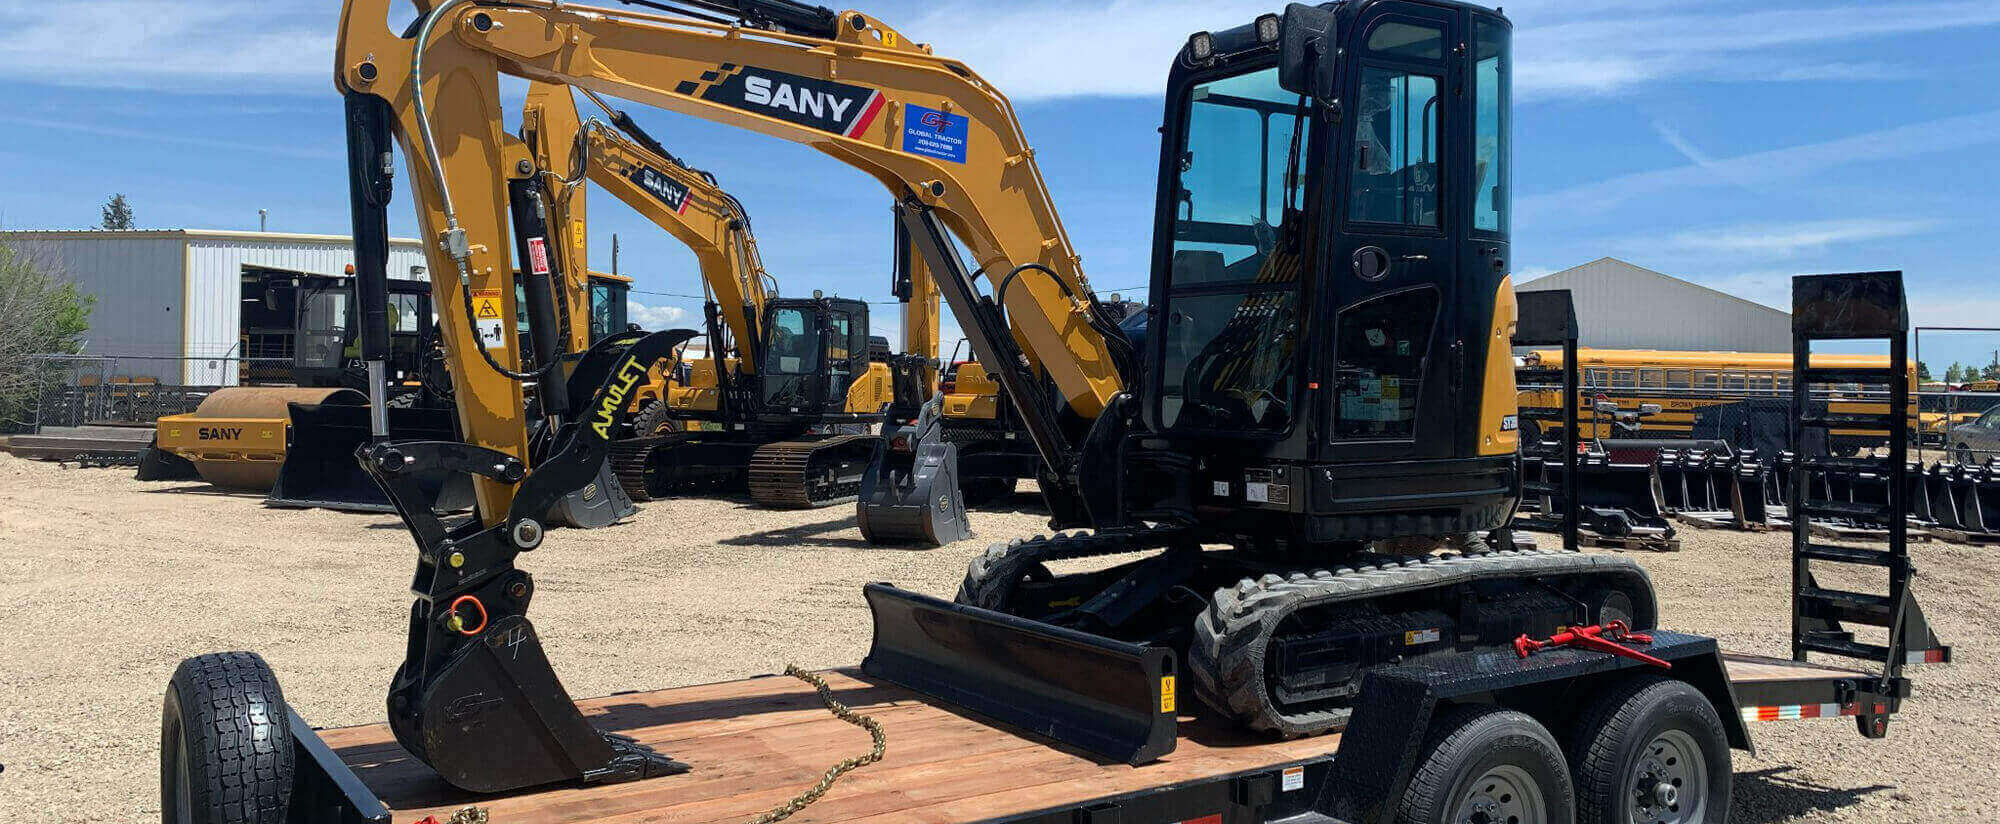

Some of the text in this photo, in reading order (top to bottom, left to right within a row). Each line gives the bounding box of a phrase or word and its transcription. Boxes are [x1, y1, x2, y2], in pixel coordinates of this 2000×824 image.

[744, 75, 853, 122] SANY
[908, 129, 932, 139] GLOBAL
[934, 133, 962, 145] TRACTOR
[643, 169, 682, 205] SANY
[592, 355, 647, 440] AMULET
[198, 427, 243, 441] SANY
[508, 629, 527, 660] 4
